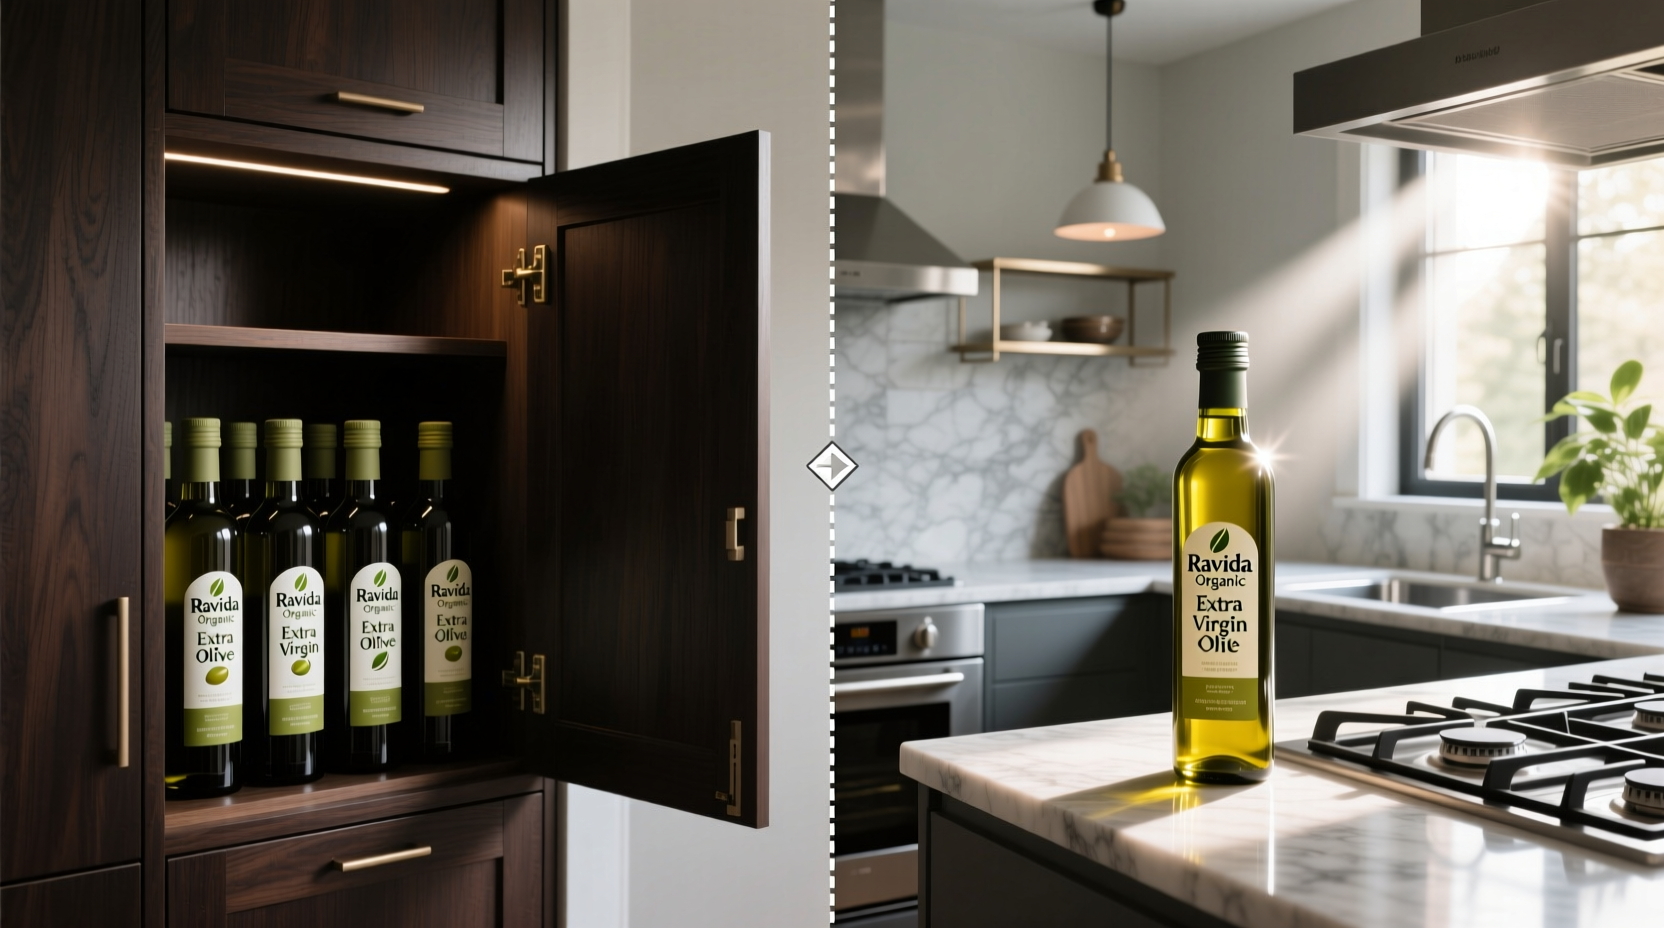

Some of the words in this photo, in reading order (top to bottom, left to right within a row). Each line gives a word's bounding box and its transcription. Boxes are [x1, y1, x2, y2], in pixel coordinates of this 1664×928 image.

[1187, 553, 1253, 573] Ravida
[191, 596, 239, 613] Ravida
[276, 591, 321, 607] Ravida
[1196, 595, 1243, 612] Extra
[362, 620, 395, 634] Extra
[437, 614, 467, 627] Extra
[1193, 615, 1248, 637] Virgin
[197, 632, 234, 646] Extra
[281, 626, 317, 640] Extra
[196, 647, 235, 663] Olive
[279, 641, 319, 658] Virgin
